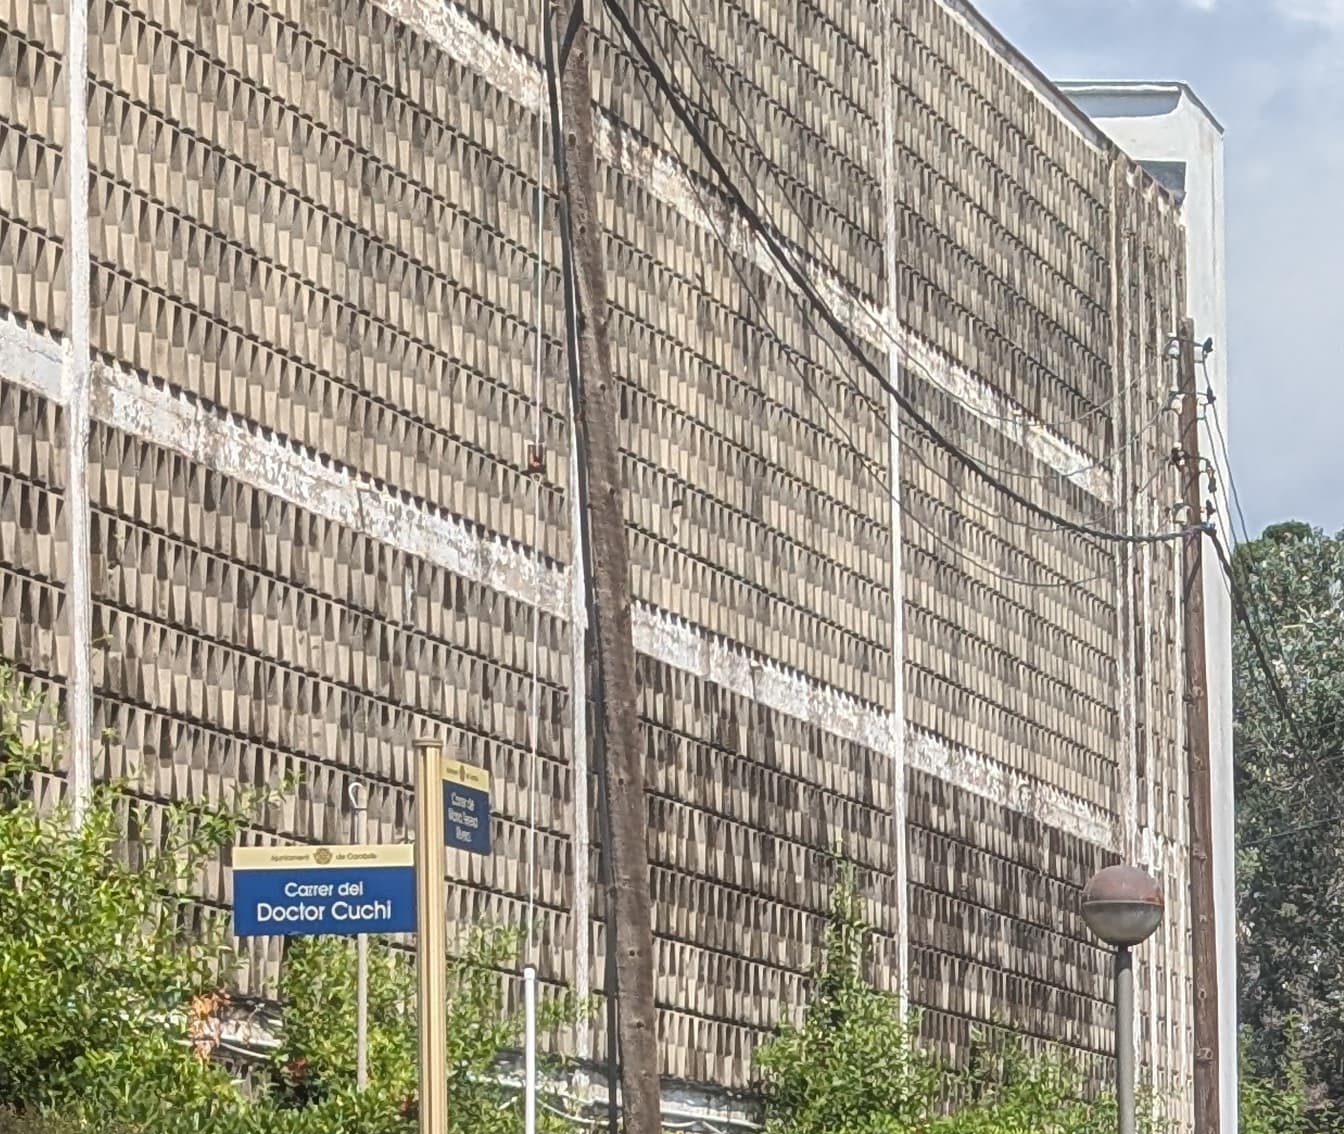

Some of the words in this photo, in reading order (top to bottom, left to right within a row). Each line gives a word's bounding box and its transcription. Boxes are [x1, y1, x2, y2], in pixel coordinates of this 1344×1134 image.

[284, 882, 334, 897] Carrer
[338, 881, 363, 896] del
[257, 901, 325, 922] Doctor
